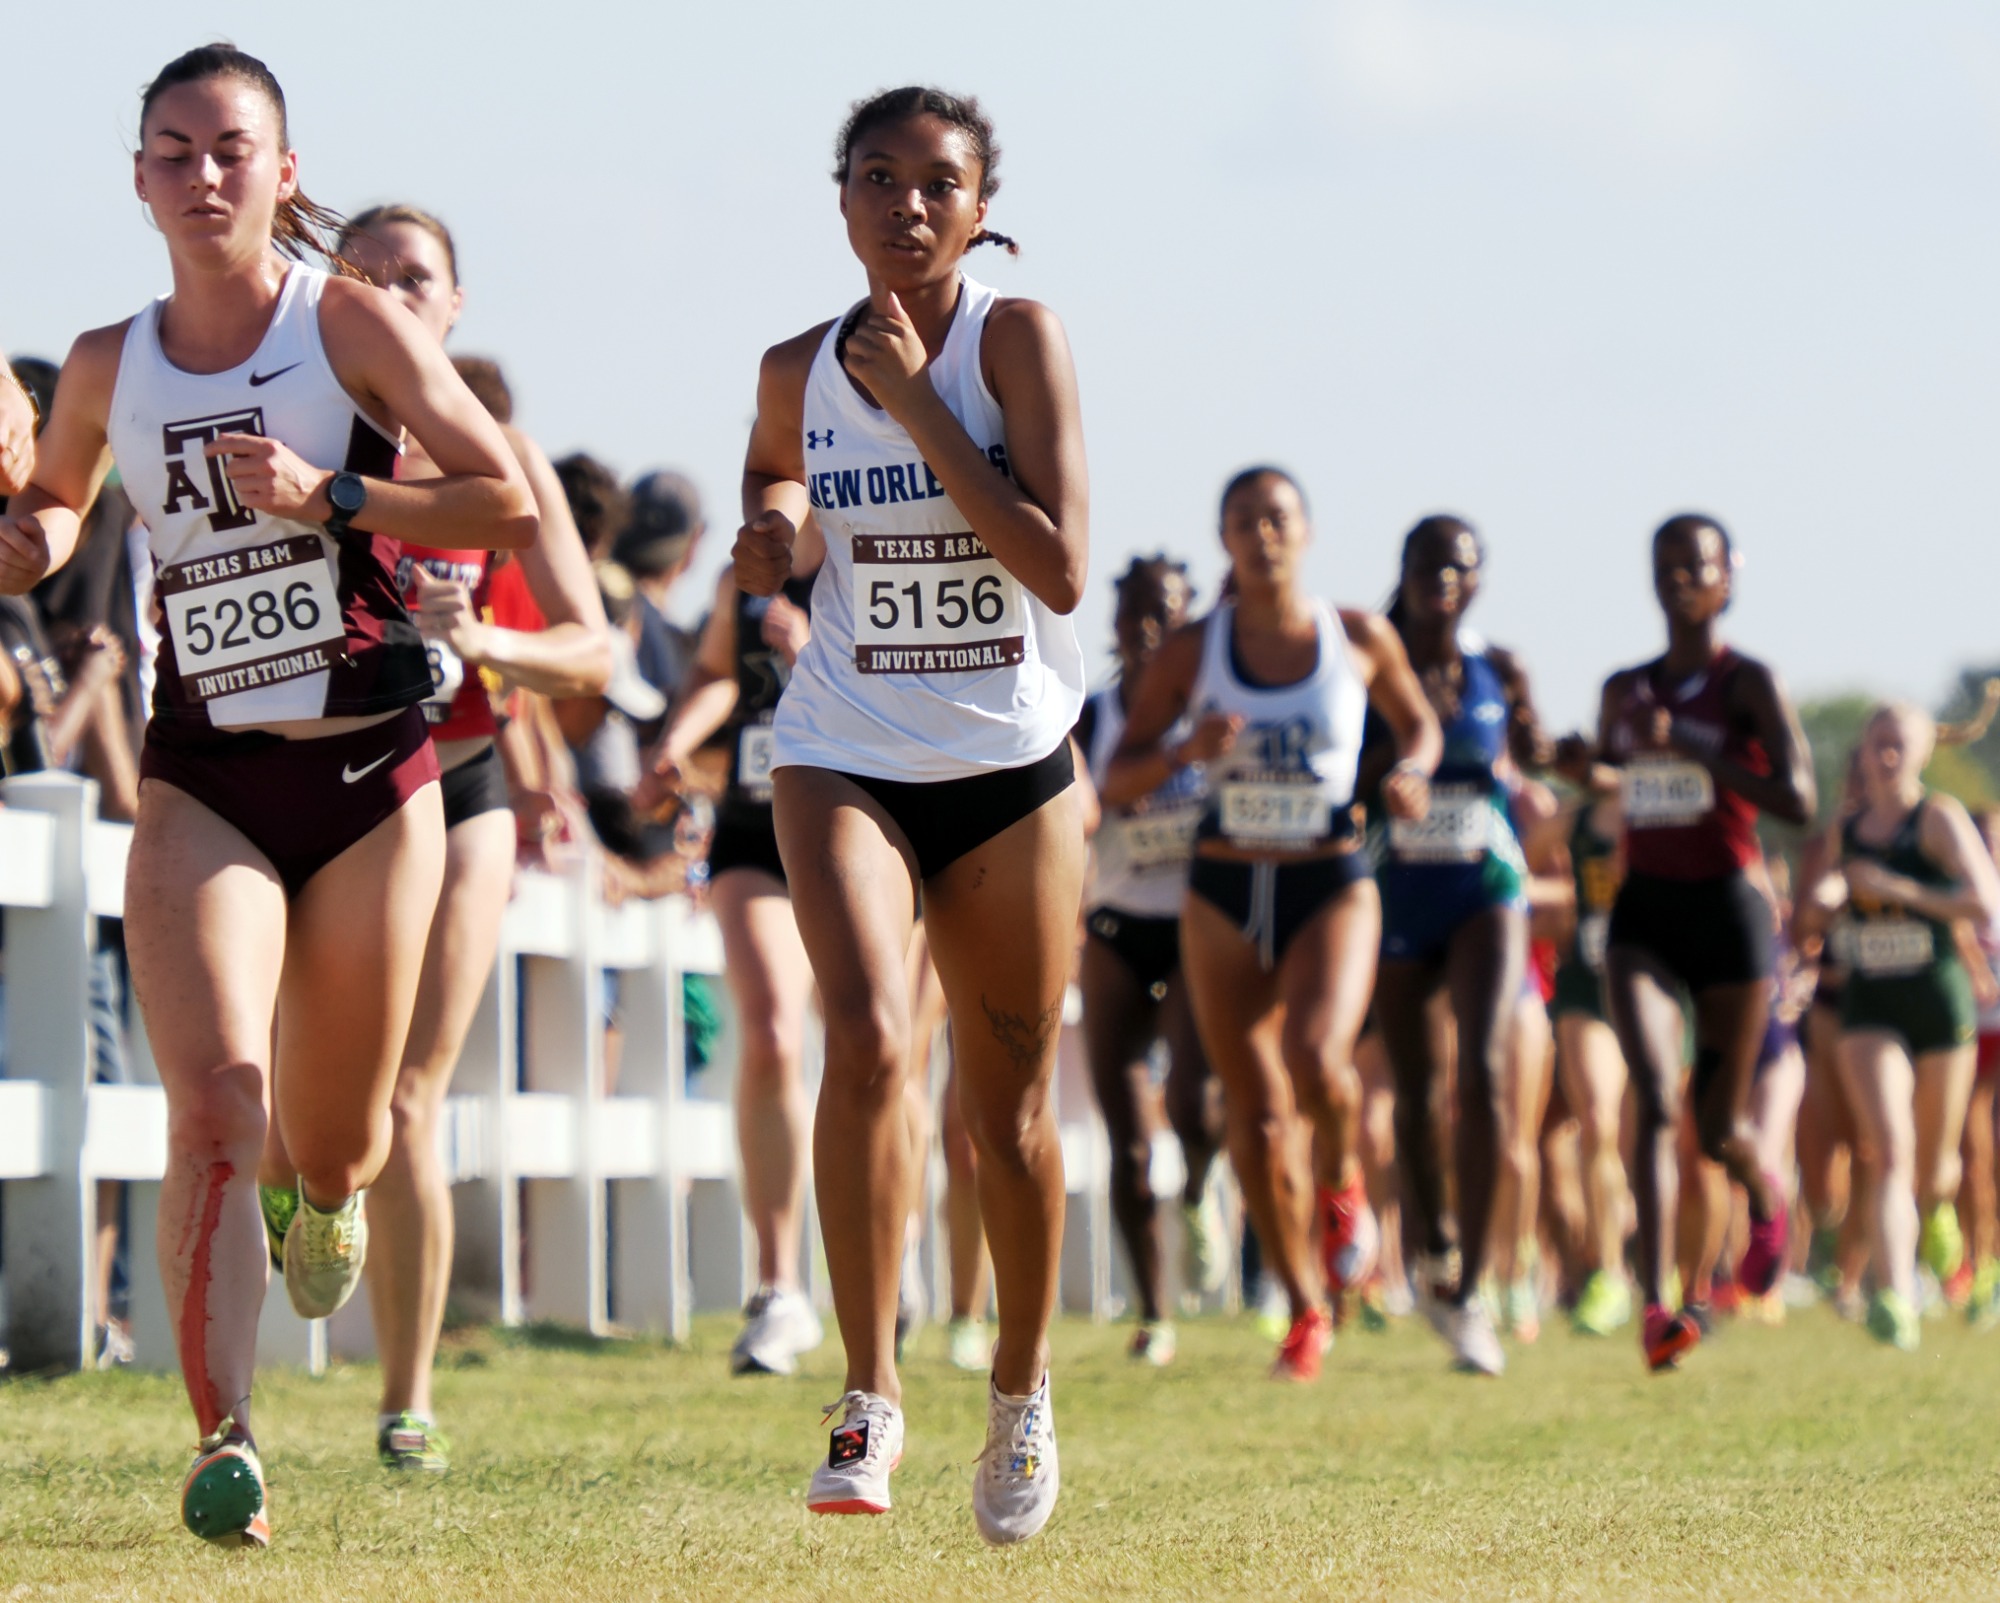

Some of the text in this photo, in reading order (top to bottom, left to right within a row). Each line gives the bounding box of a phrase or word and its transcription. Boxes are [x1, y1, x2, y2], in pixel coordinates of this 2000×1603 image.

[808, 444, 1010, 510] NEW ORLES
[182, 544, 294, 586] TEXAS A&M
[874, 536, 988, 559] TEXAS A&M
[185, 581, 320, 656] 5286
[869, 575, 1004, 630] 5156
[196, 650, 329, 698] INVITATIONAL
[872, 645, 1006, 670] INVITATIONAL
